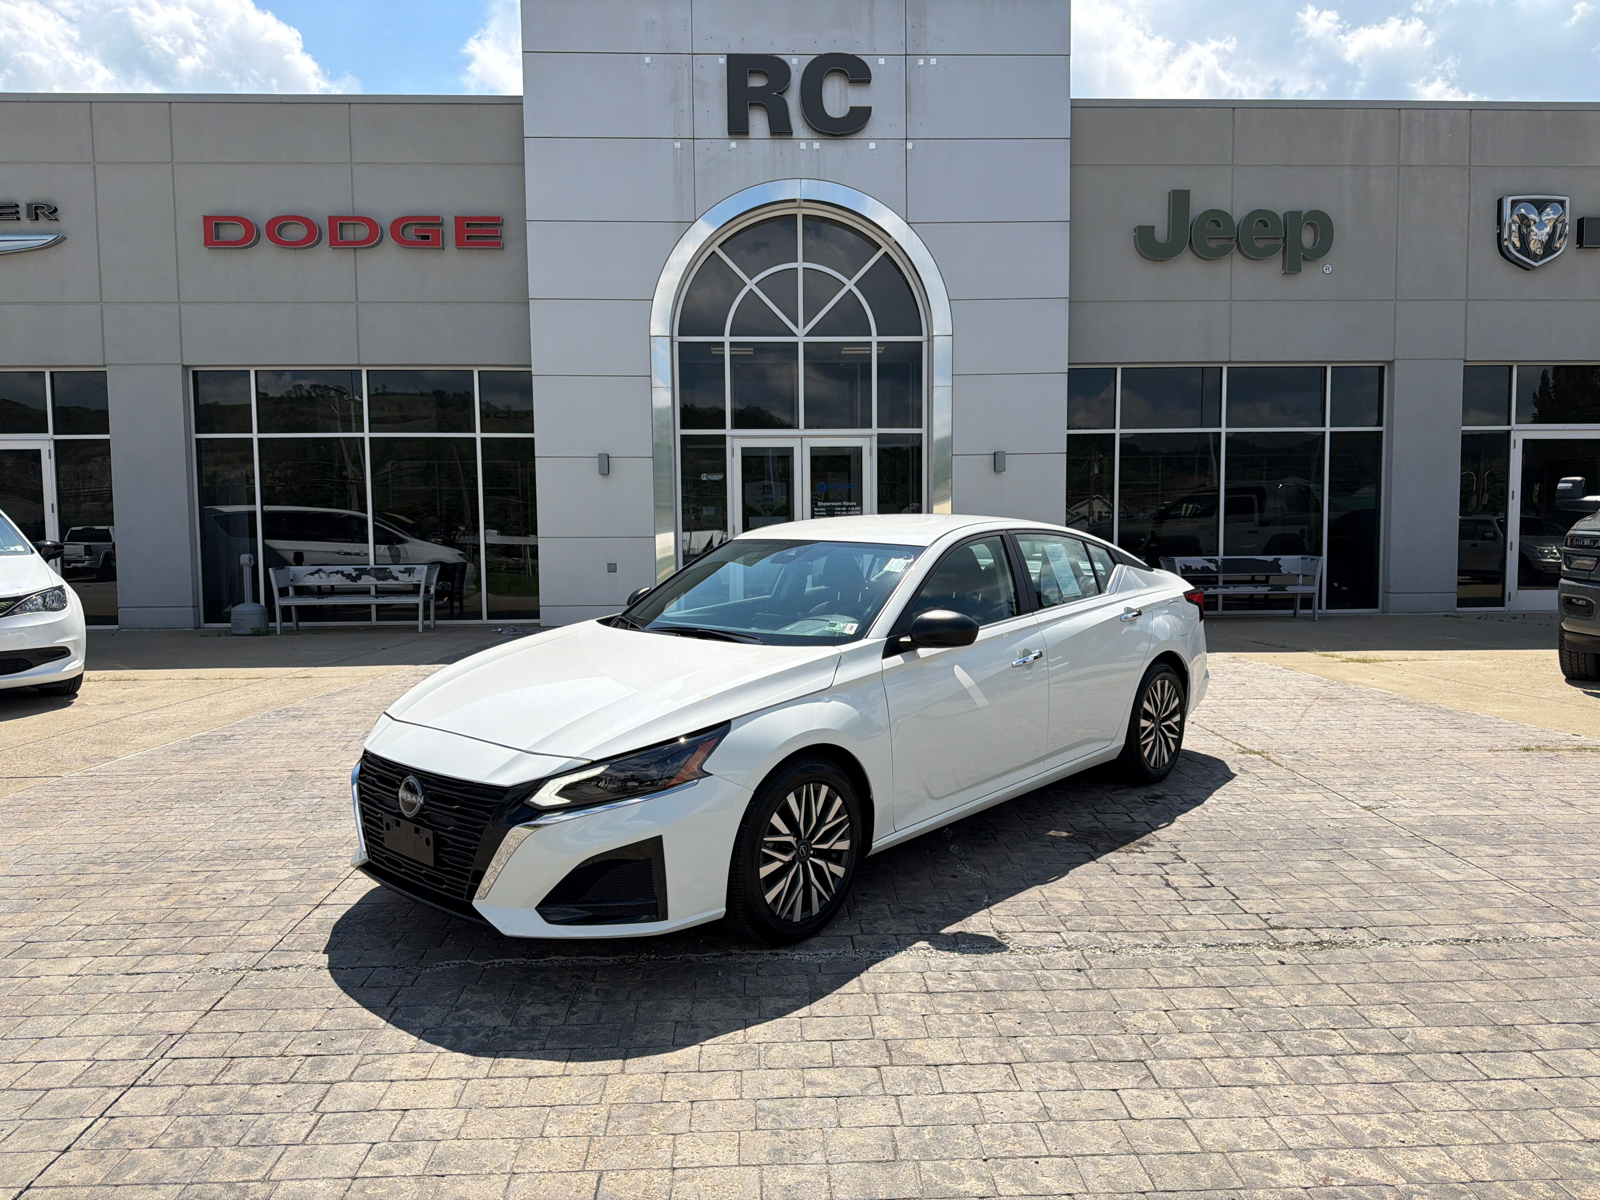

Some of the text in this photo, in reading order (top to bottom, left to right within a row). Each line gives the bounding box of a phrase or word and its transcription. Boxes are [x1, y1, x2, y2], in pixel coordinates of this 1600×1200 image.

[727, 52, 872, 137] RC
[203, 214, 504, 249] DODGE
[1133, 189, 1334, 275] Jeep
